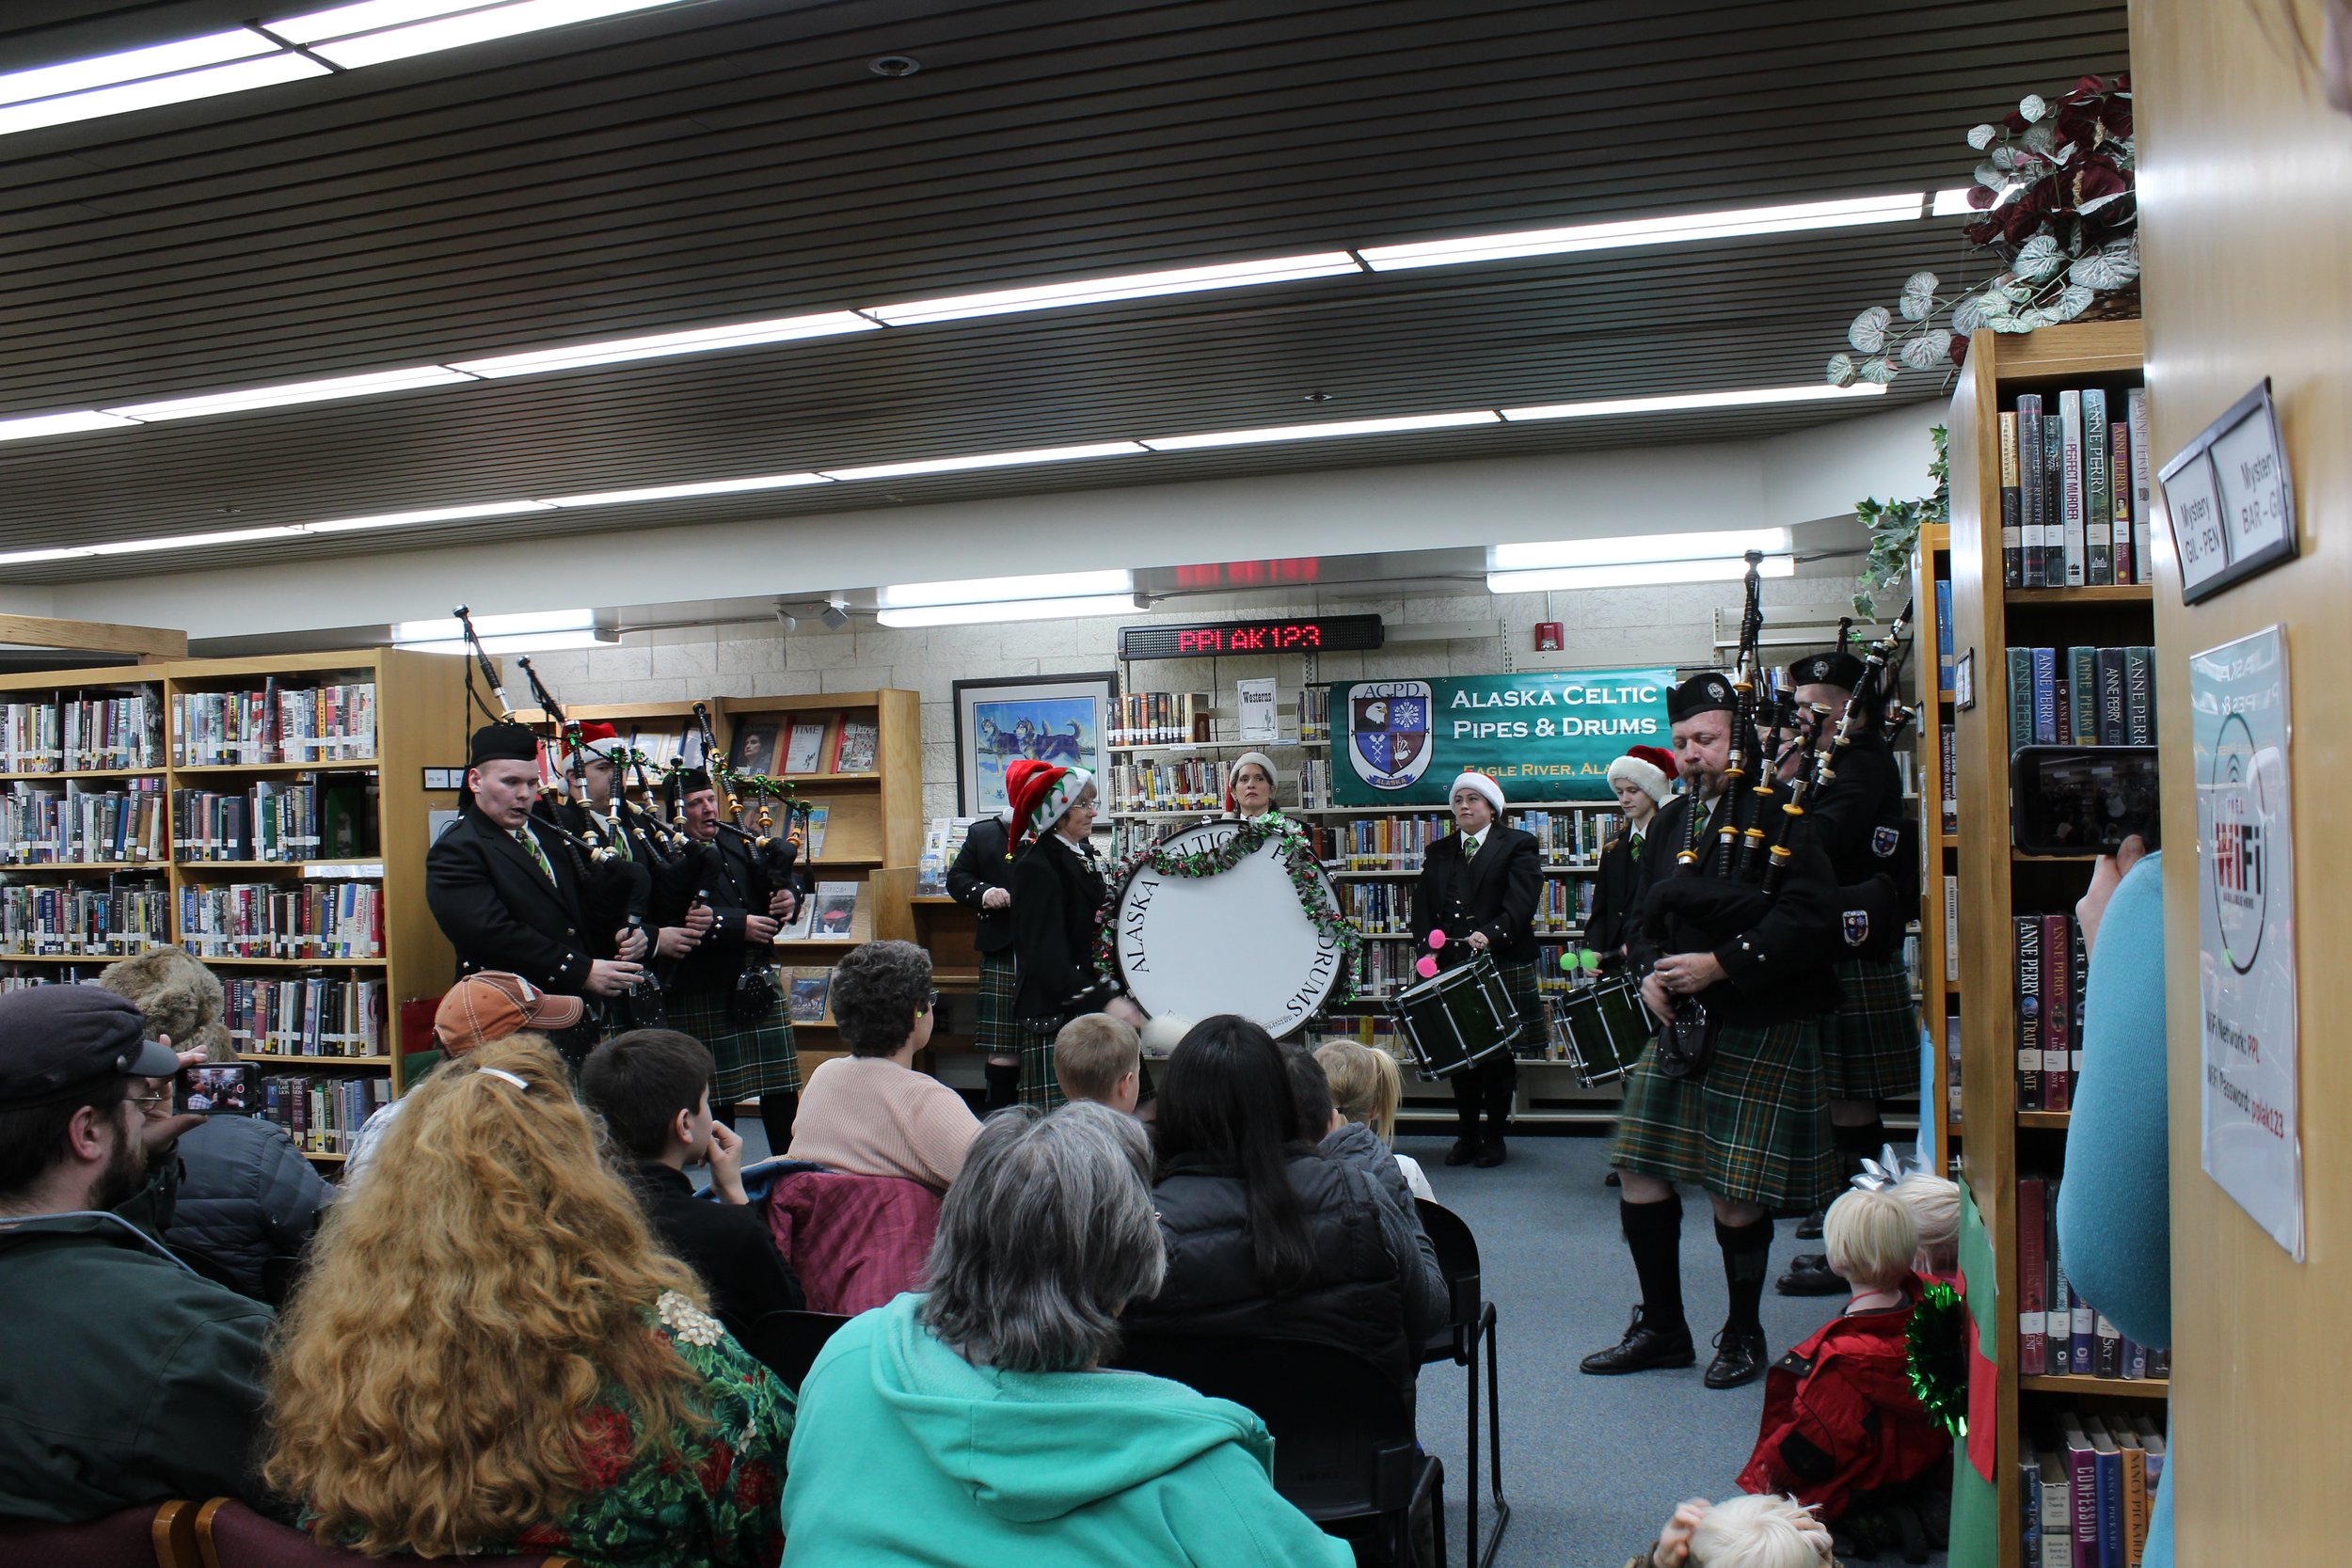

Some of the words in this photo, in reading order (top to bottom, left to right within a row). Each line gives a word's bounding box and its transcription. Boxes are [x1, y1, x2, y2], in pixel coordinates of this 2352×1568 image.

[2089, 402, 2103, 443] ANNE
[2114, 427, 2126, 456] ANNE
[2065, 443, 2077, 481] PERFECT
[2090, 446, 2105, 497] PERRY
[2115, 460, 2127, 494] PERRY
[2067, 483, 2078, 520] MURDER
[2180, 496, 2211, 531] Mystery
[2185, 540, 2200, 563] GIL
[2202, 529, 2220, 558] PEN
[2017, 658, 2030, 701] ANNE
[2038, 654, 2052, 686] ANNE
[2078, 656, 2092, 689] ANNE
[2106, 667, 2120, 694] ANNE
[2131, 657, 2146, 702] ANNE
[1242, 689, 1273, 705] Westerns
[1364, 683, 1420, 698] ACPD
[1451, 689, 1556, 708] ALASKA
[1563, 685, 1658, 705] CELTIC
[2040, 689, 2053, 725] PERRY
[282, 707, 294, 733] JAPAN'S
[2017, 704, 2032, 745] PERRY
[2079, 695, 2093, 733] PERRY
[2107, 696, 2121, 723] PERRY
[2133, 705, 2147, 745] PERR
[794, 725, 820, 735] TIME
[1453, 720, 1520, 739] PIPES
[1534, 718, 1555, 737] &
[1562, 716, 1658, 736] DRUMS
[1375, 776, 1407, 787] ALASKA
[1521, 763, 1576, 777] RIVER,
[2216, 822, 2261, 895] WiFi
[1125, 879, 1160, 973] ALASKA
[2020, 922, 2039, 957] ANNE
[2053, 925, 2064, 958] ANNE
[1286, 933, 1336, 1017] DRUMS
[2022, 958, 2039, 997] PERRY
[2054, 961, 2064, 998] PERRY
[2248, 1035, 2260, 1064] PPL
[2102, 1337, 2115, 1360] SKY
[2106, 1467, 2115, 1501] NANCY
[2131, 1454, 2141, 1497] NANCY
[2076, 1465, 2096, 1543] CONFESSION
[2132, 1500, 2143, 1559] PICKARD
